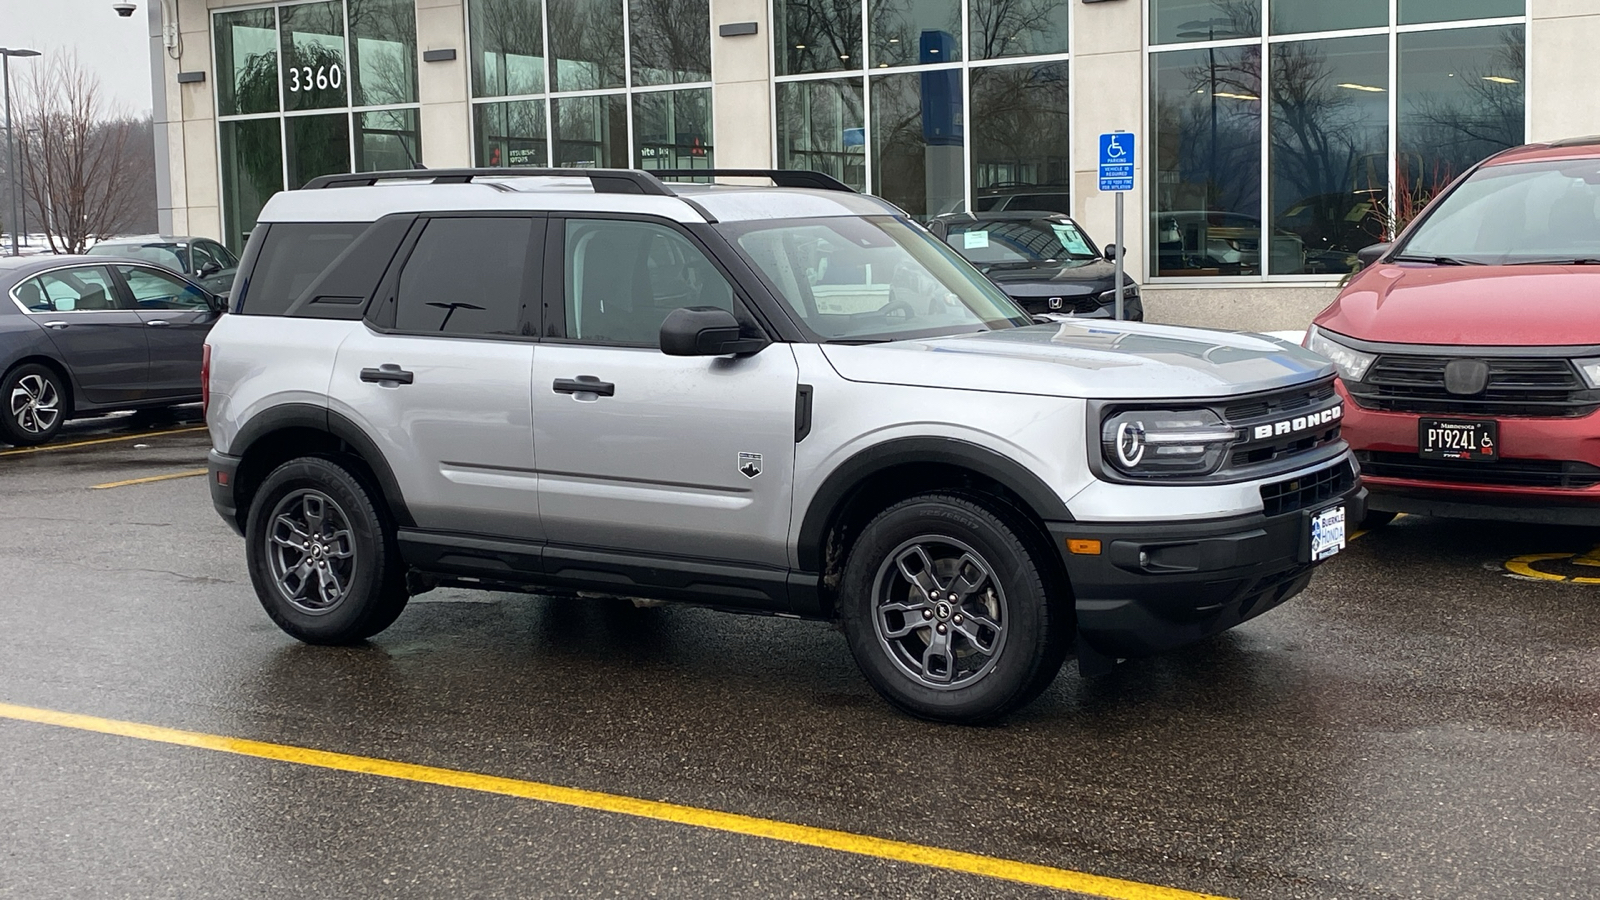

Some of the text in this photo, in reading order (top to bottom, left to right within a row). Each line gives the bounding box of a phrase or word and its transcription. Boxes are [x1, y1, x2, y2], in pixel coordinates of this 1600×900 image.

[289, 64, 341, 92] 3360
[1254, 406, 1341, 439] BRONCO
[1428, 429, 1477, 449] PT9241
[1322, 513, 1344, 528] BUERKLE
[1322, 526, 1343, 545] HONDA
